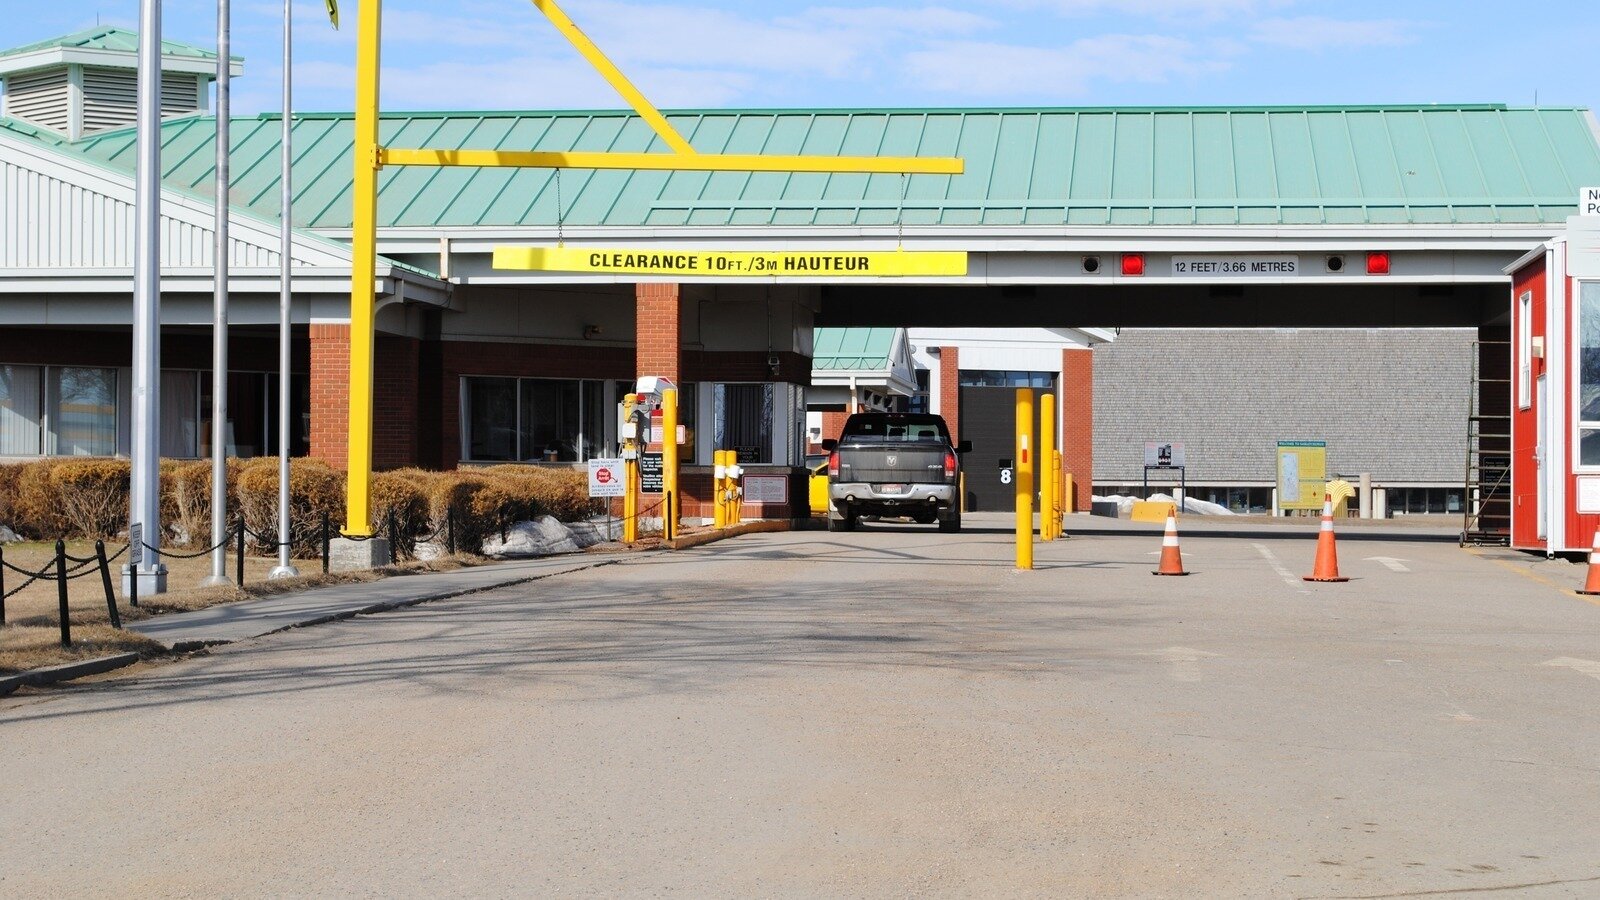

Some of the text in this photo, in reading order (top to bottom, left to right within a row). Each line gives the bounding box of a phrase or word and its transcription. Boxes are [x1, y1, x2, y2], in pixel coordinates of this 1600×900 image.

[589, 252, 869, 272] CLEARANCE 10FT./3M HAUTEUR
[1175, 261, 1295, 273] 12 FEET/3.66 METRES
[1000, 469, 1011, 484] 8
